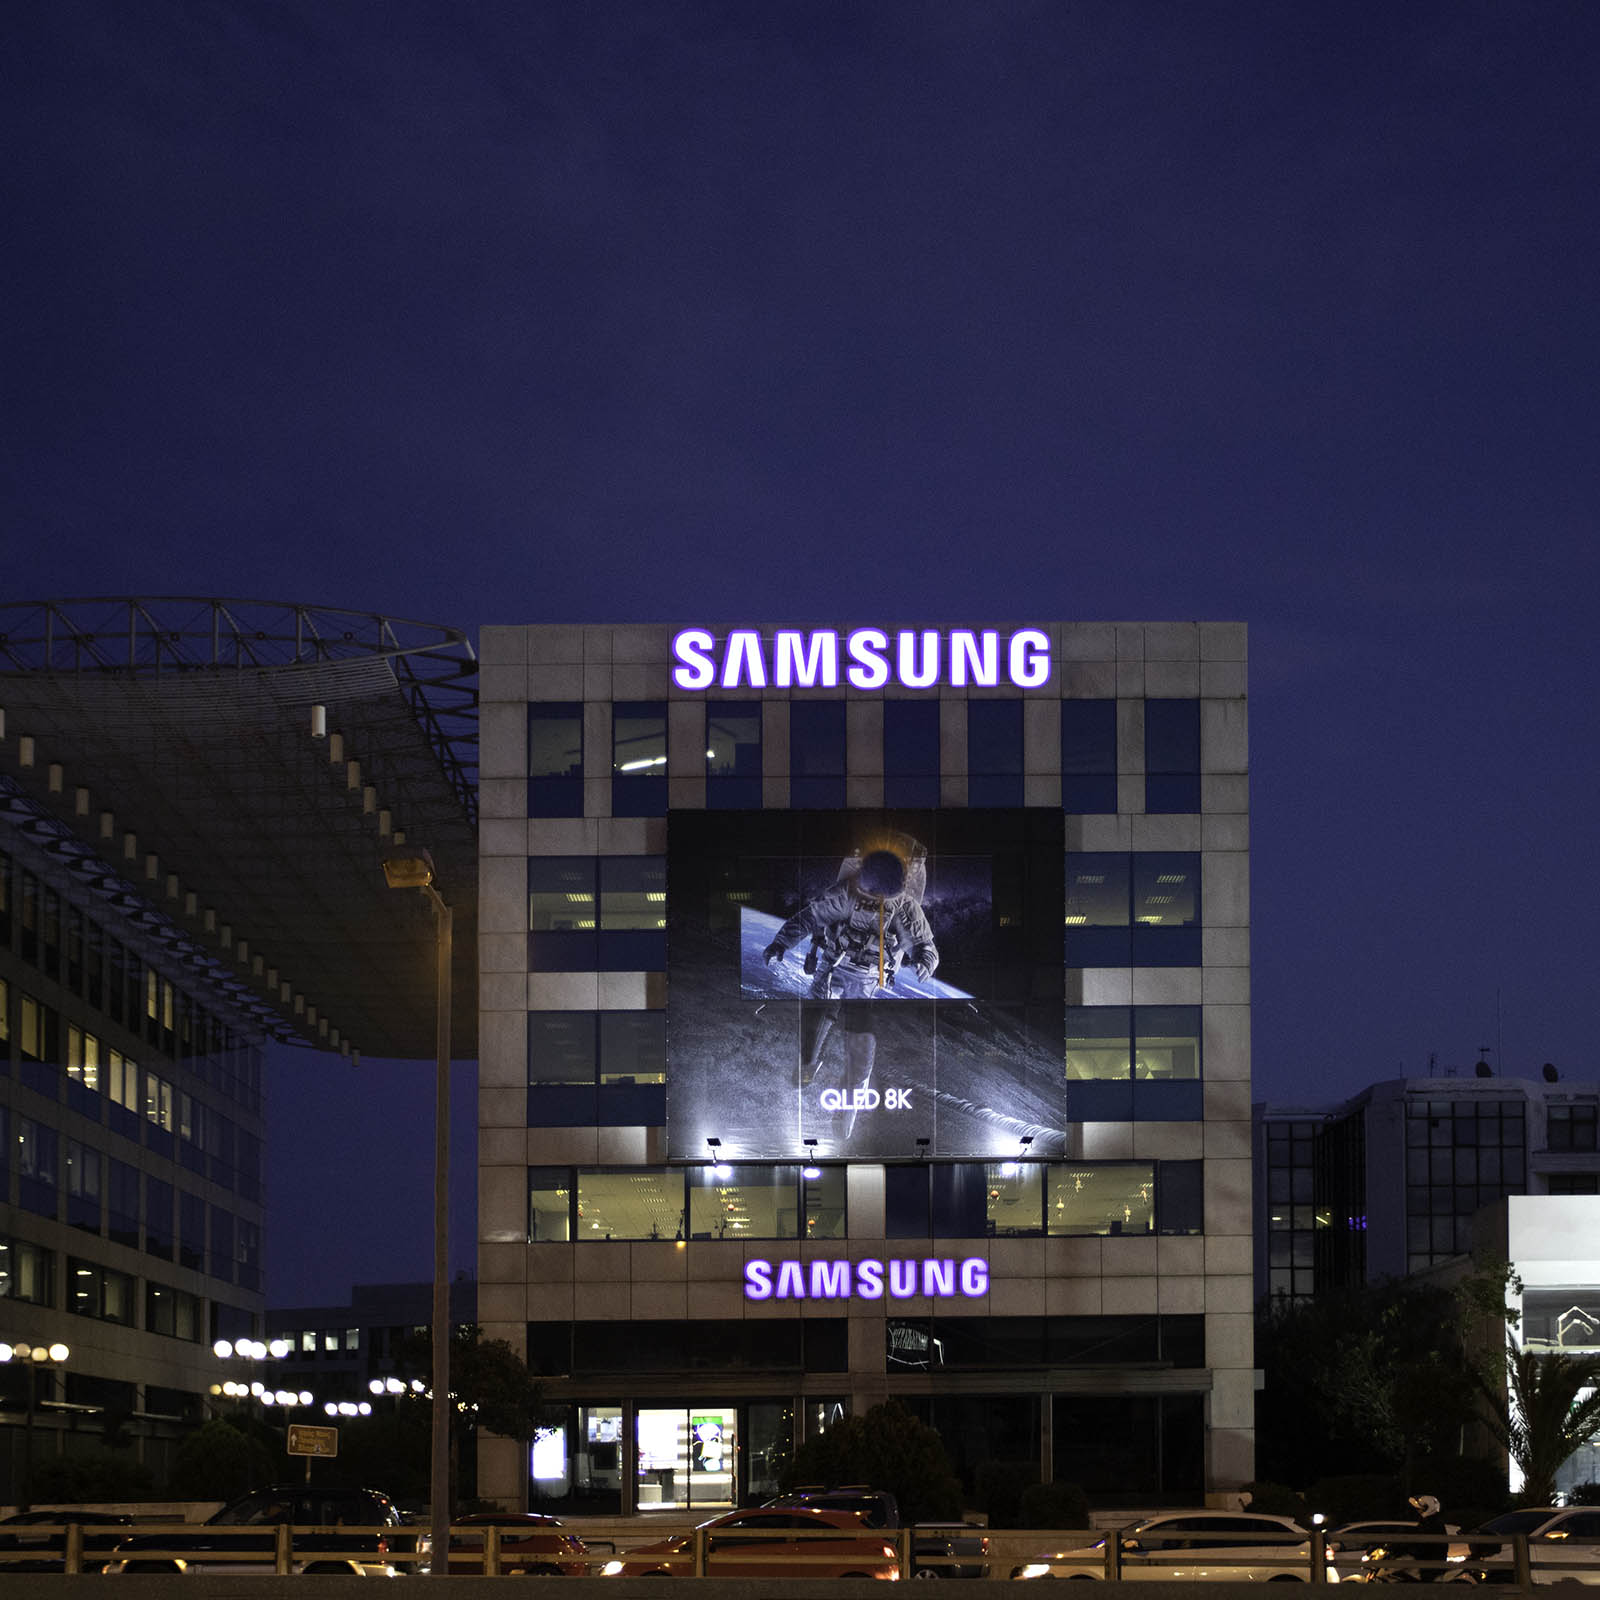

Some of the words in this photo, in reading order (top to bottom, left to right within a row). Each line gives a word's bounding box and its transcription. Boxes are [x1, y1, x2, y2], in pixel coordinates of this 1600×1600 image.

[673, 629, 1051, 689] SAMSUNG
[820, 1088, 880, 1110] QLED
[884, 1088, 913, 1110] 8K
[745, 1259, 989, 1299] SAMSUNG
